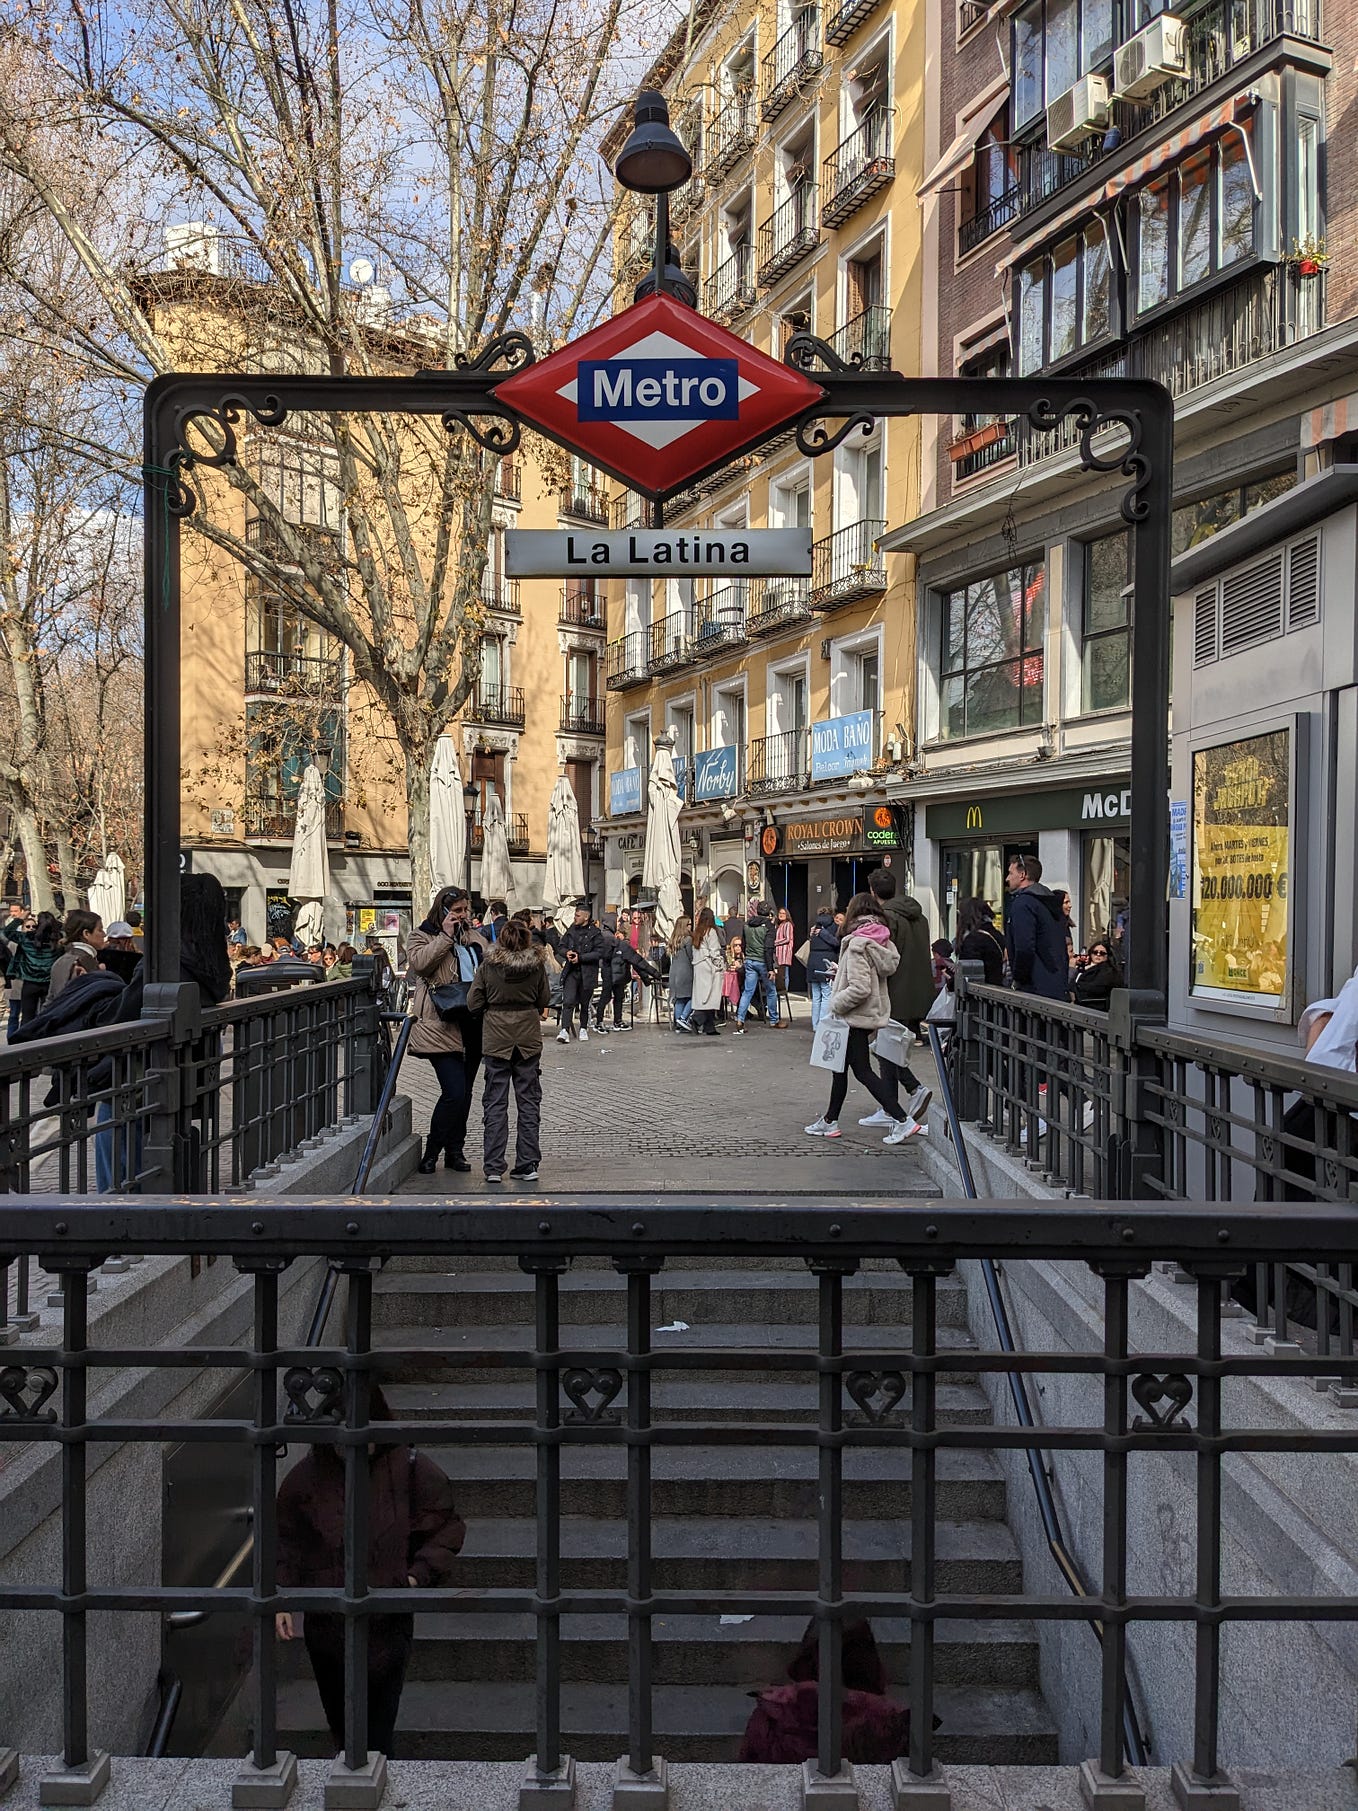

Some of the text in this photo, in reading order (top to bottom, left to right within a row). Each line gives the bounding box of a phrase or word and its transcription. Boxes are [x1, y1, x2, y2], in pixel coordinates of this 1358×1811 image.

[593, 368, 727, 408] Metro
[566, 536, 751, 564] La Latina
[813, 716, 870, 755] MODA BAÑO
[787, 818, 863, 840] ROYAL CROWN
